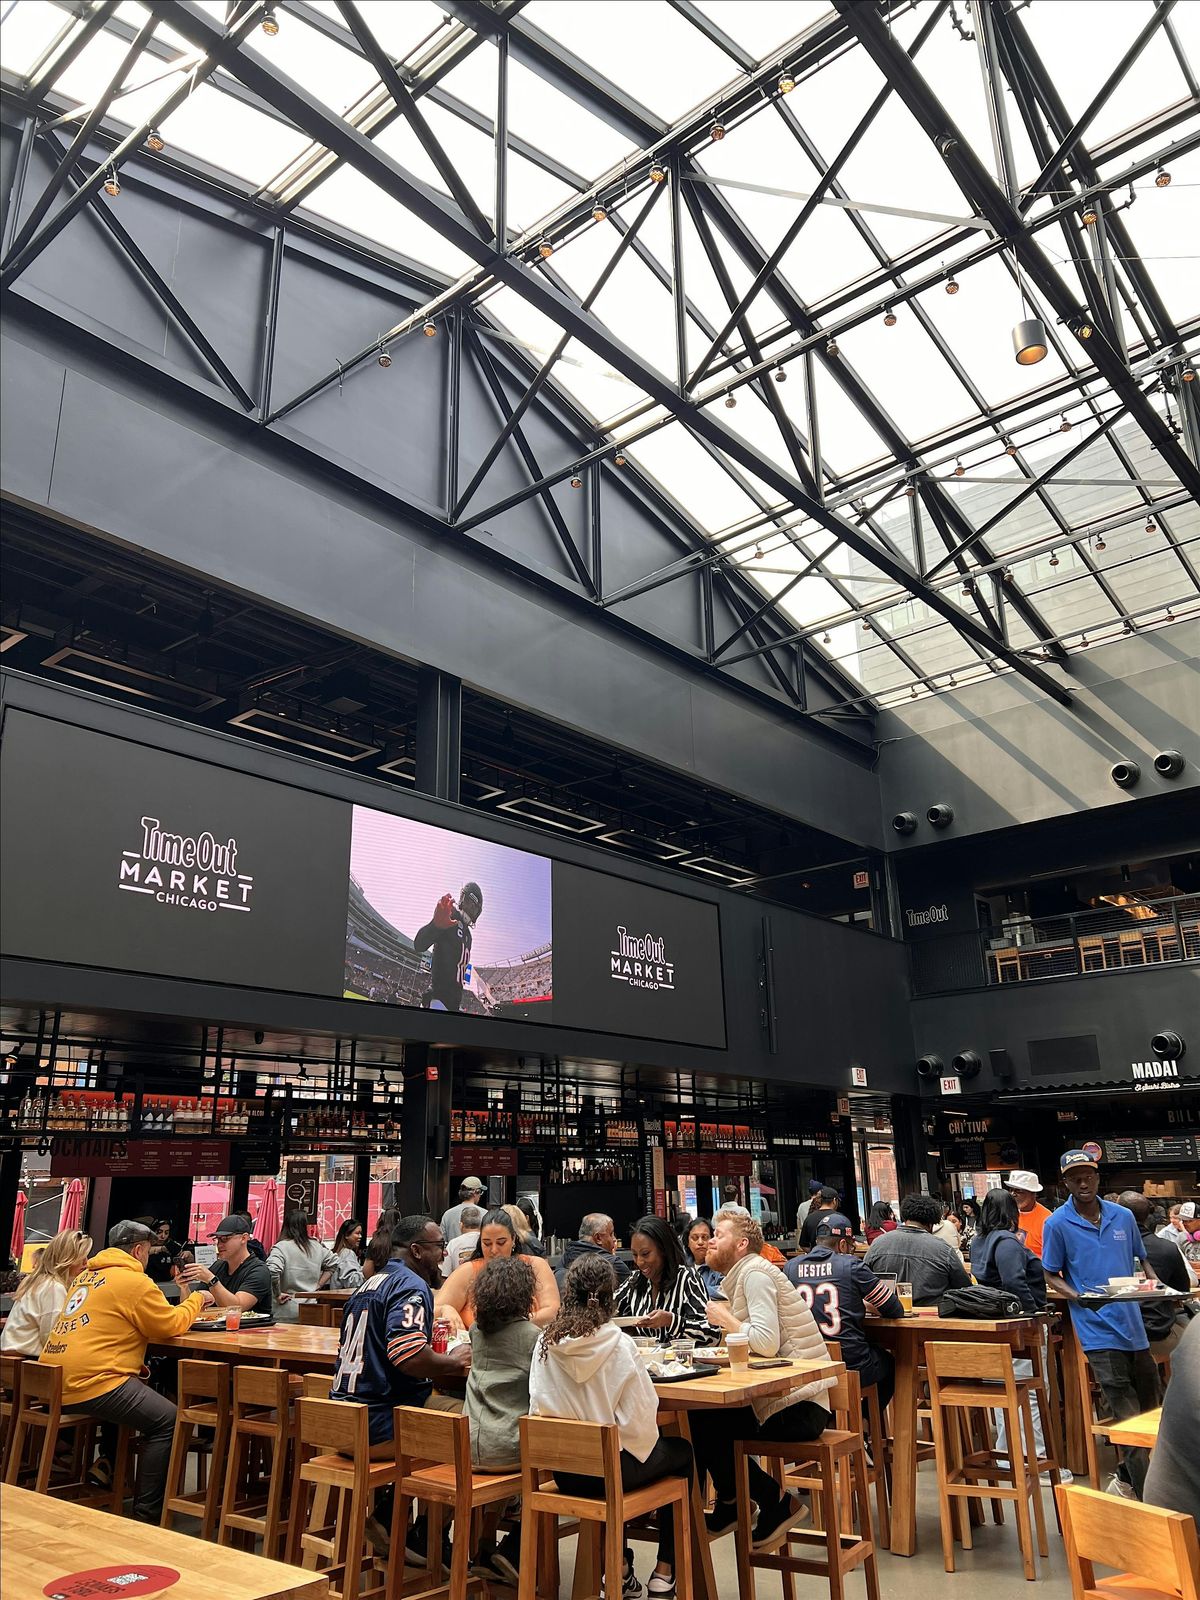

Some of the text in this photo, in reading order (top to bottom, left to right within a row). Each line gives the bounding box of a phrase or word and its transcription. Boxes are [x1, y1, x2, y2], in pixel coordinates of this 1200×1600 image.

[141, 816, 238, 876] Time Out
[119, 859, 253, 903] MARKET
[855, 873, 866, 883] EXIT
[156, 891, 218, 911] CHICAGO
[906, 904, 949, 927] Time Out
[617, 925, 666, 964] Time Out
[611, 957, 674, 983] MARKET
[629, 978, 659, 990] CHICAGO
[856, 1068, 865, 1080] EXIT
[1131, 1060, 1178, 1079] MADAI
[943, 1079, 957, 1091] EXIT
[38, 1138, 126, 1156] COCKTAILS
[646, 1134, 659, 1147] BAR
[798, 1262, 832, 1278] HESTER
[401, 1303, 425, 1331] 34
